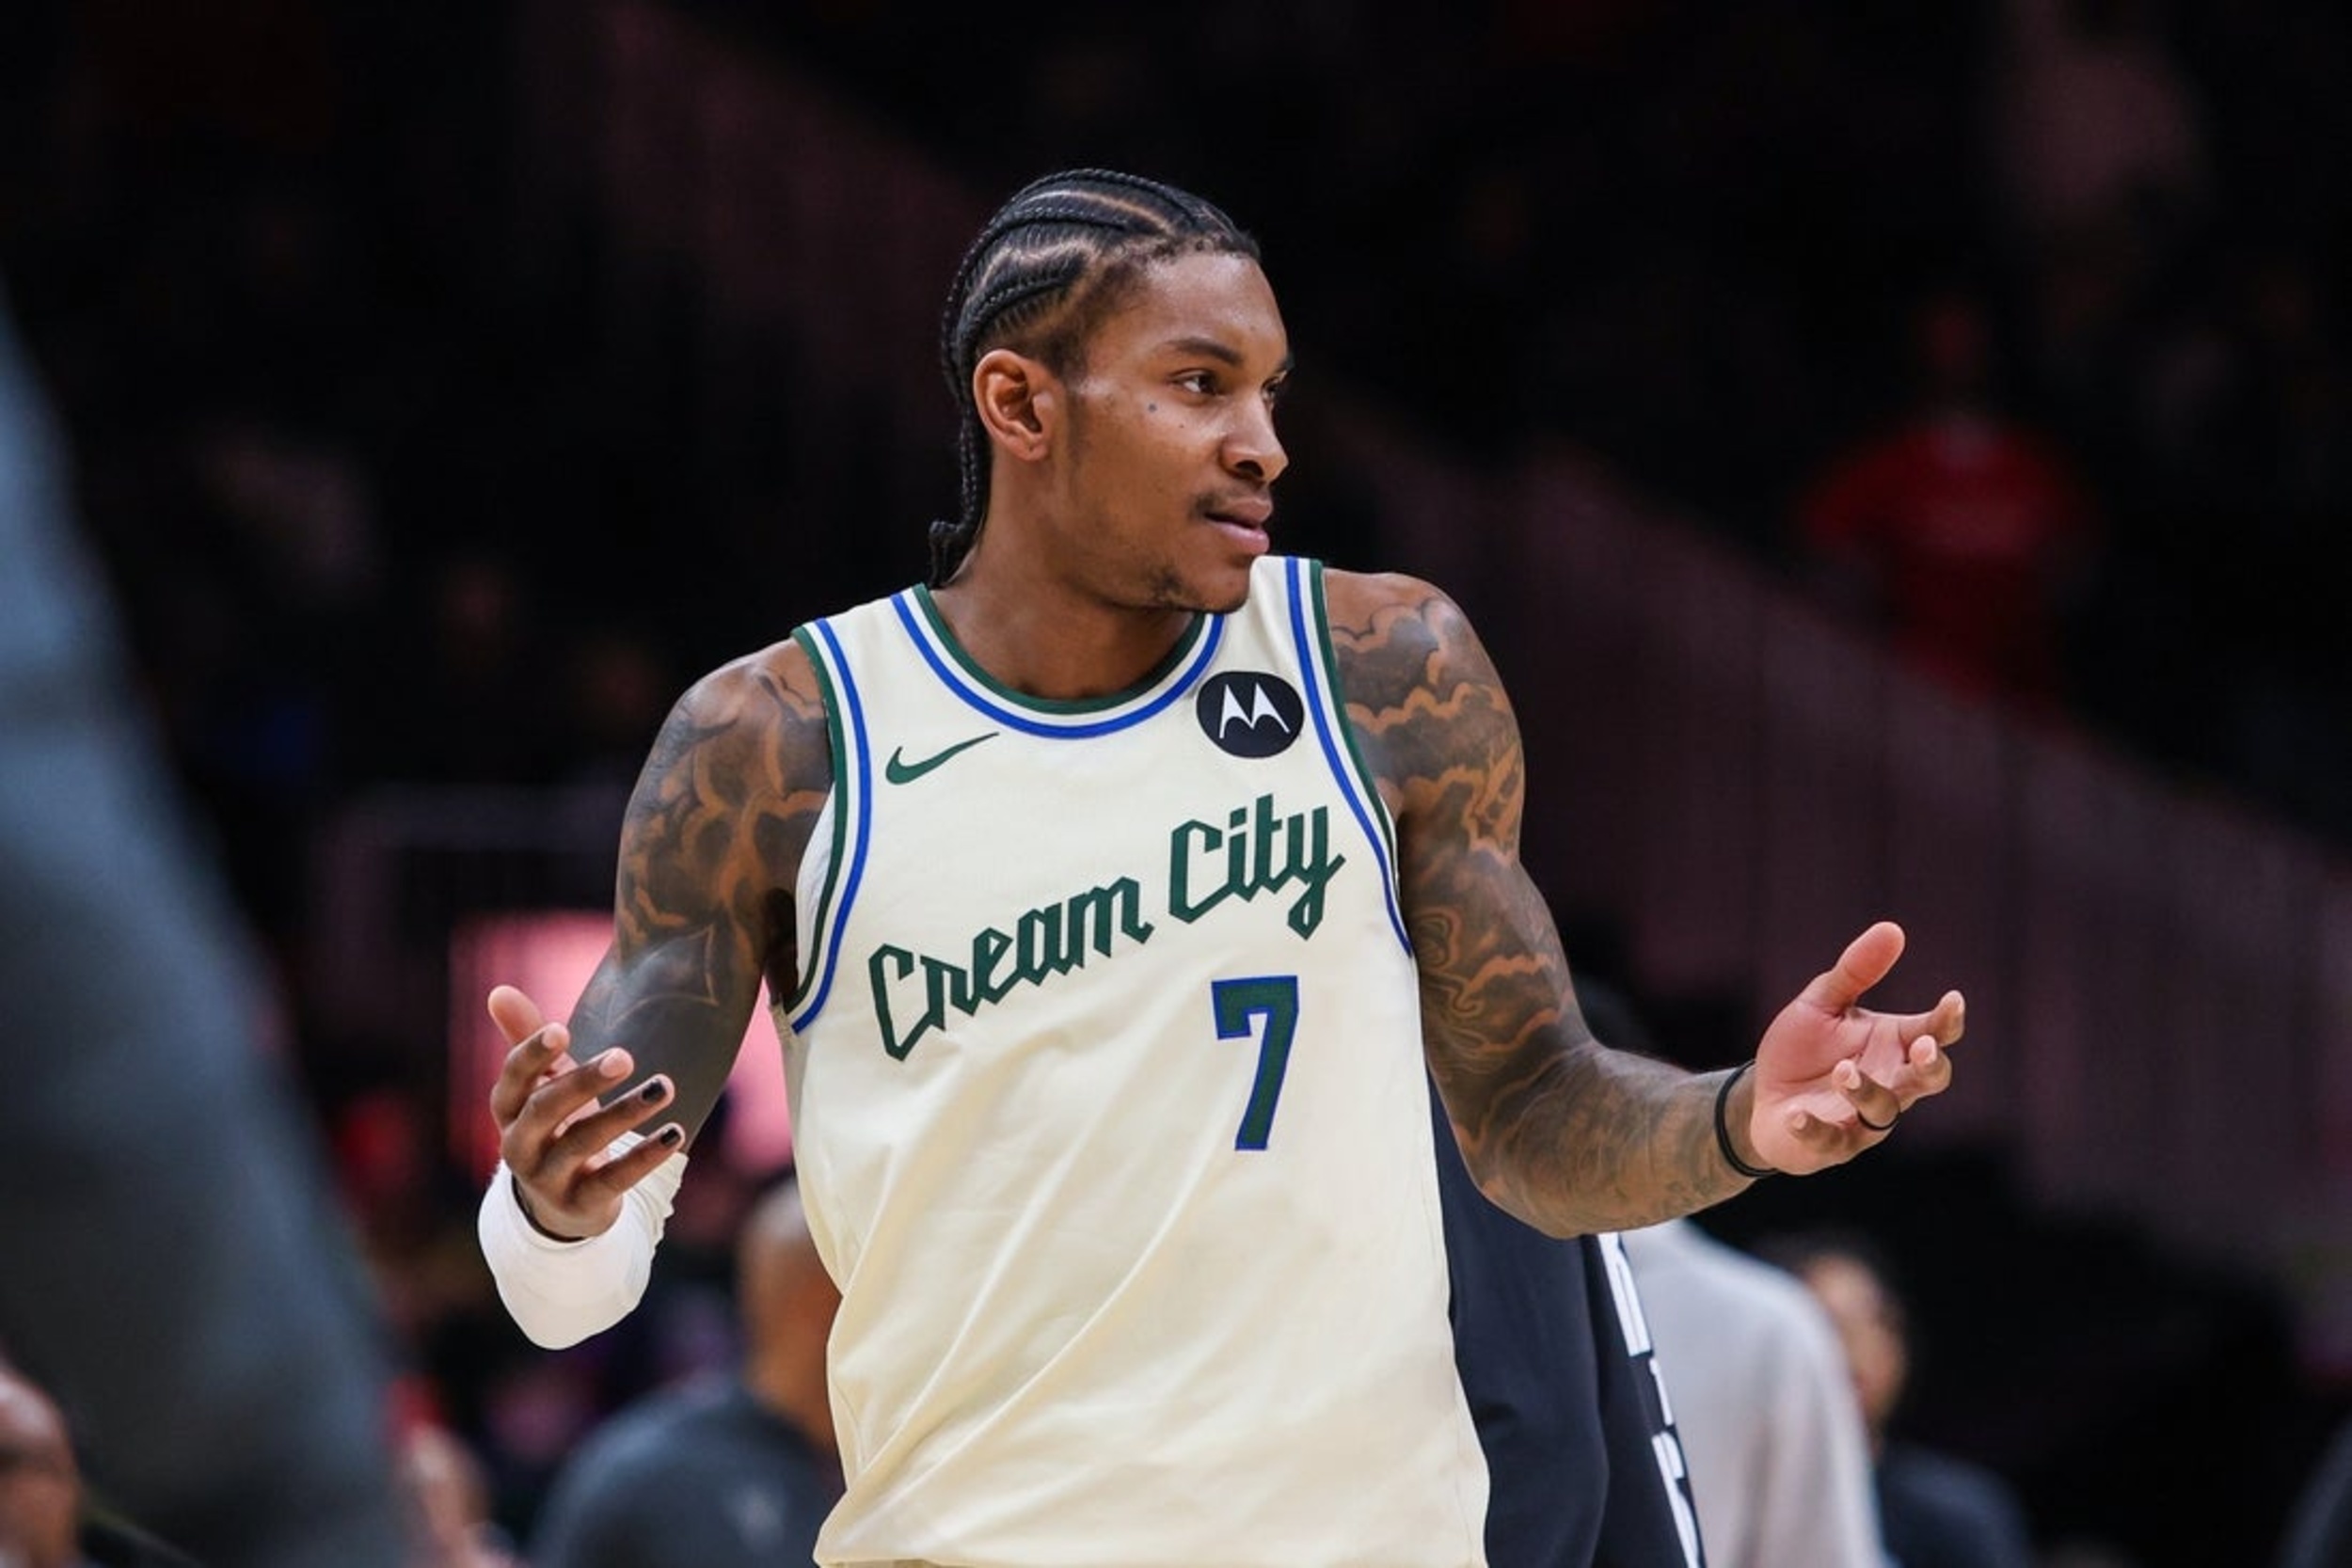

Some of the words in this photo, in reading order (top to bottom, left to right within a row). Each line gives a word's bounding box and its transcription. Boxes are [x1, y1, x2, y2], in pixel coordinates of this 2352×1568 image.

[868, 877, 1155, 1061] Cream
[1168, 794, 1346, 941] City
[1211, 975, 1299, 1150] 7
